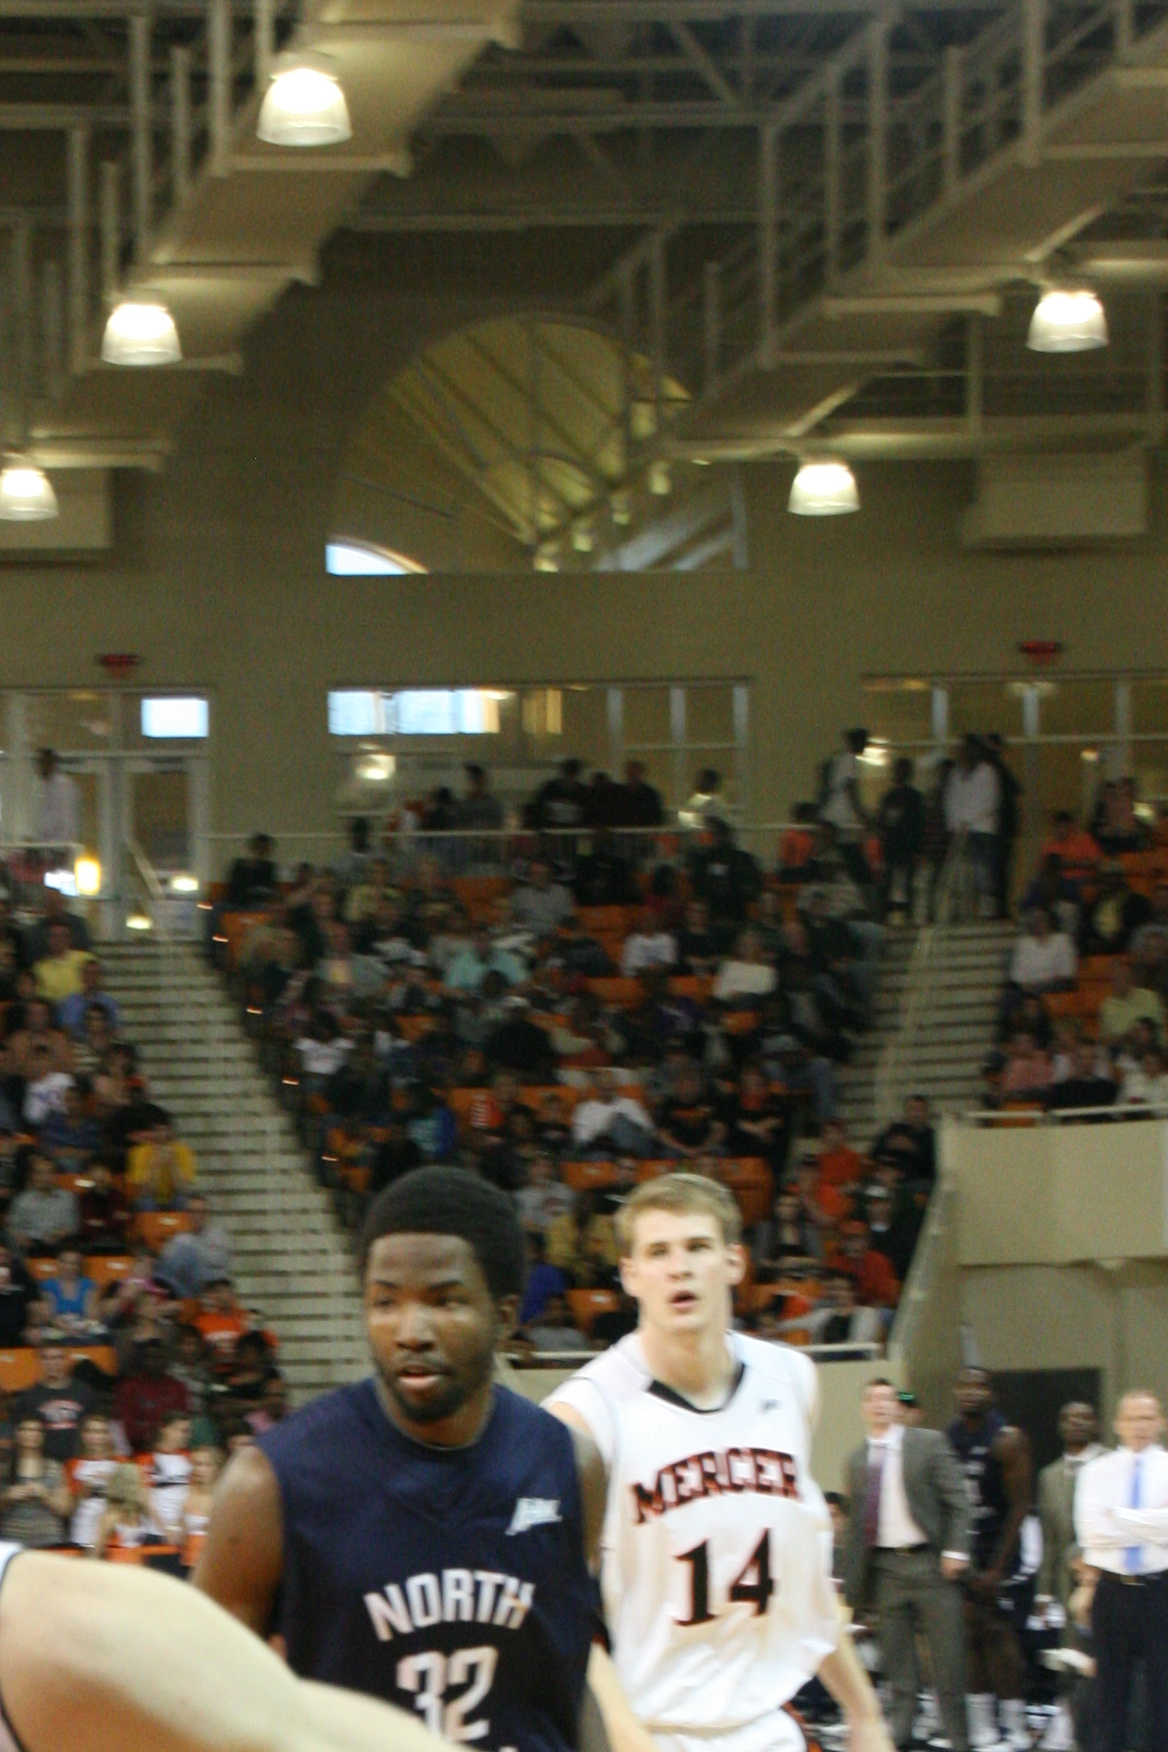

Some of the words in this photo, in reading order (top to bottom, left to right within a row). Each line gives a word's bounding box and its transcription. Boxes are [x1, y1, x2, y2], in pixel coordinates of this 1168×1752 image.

[630, 1447, 802, 1525] MERCER
[363, 1568, 536, 1642] NORTH
[672, 1527, 775, 1627] 14
